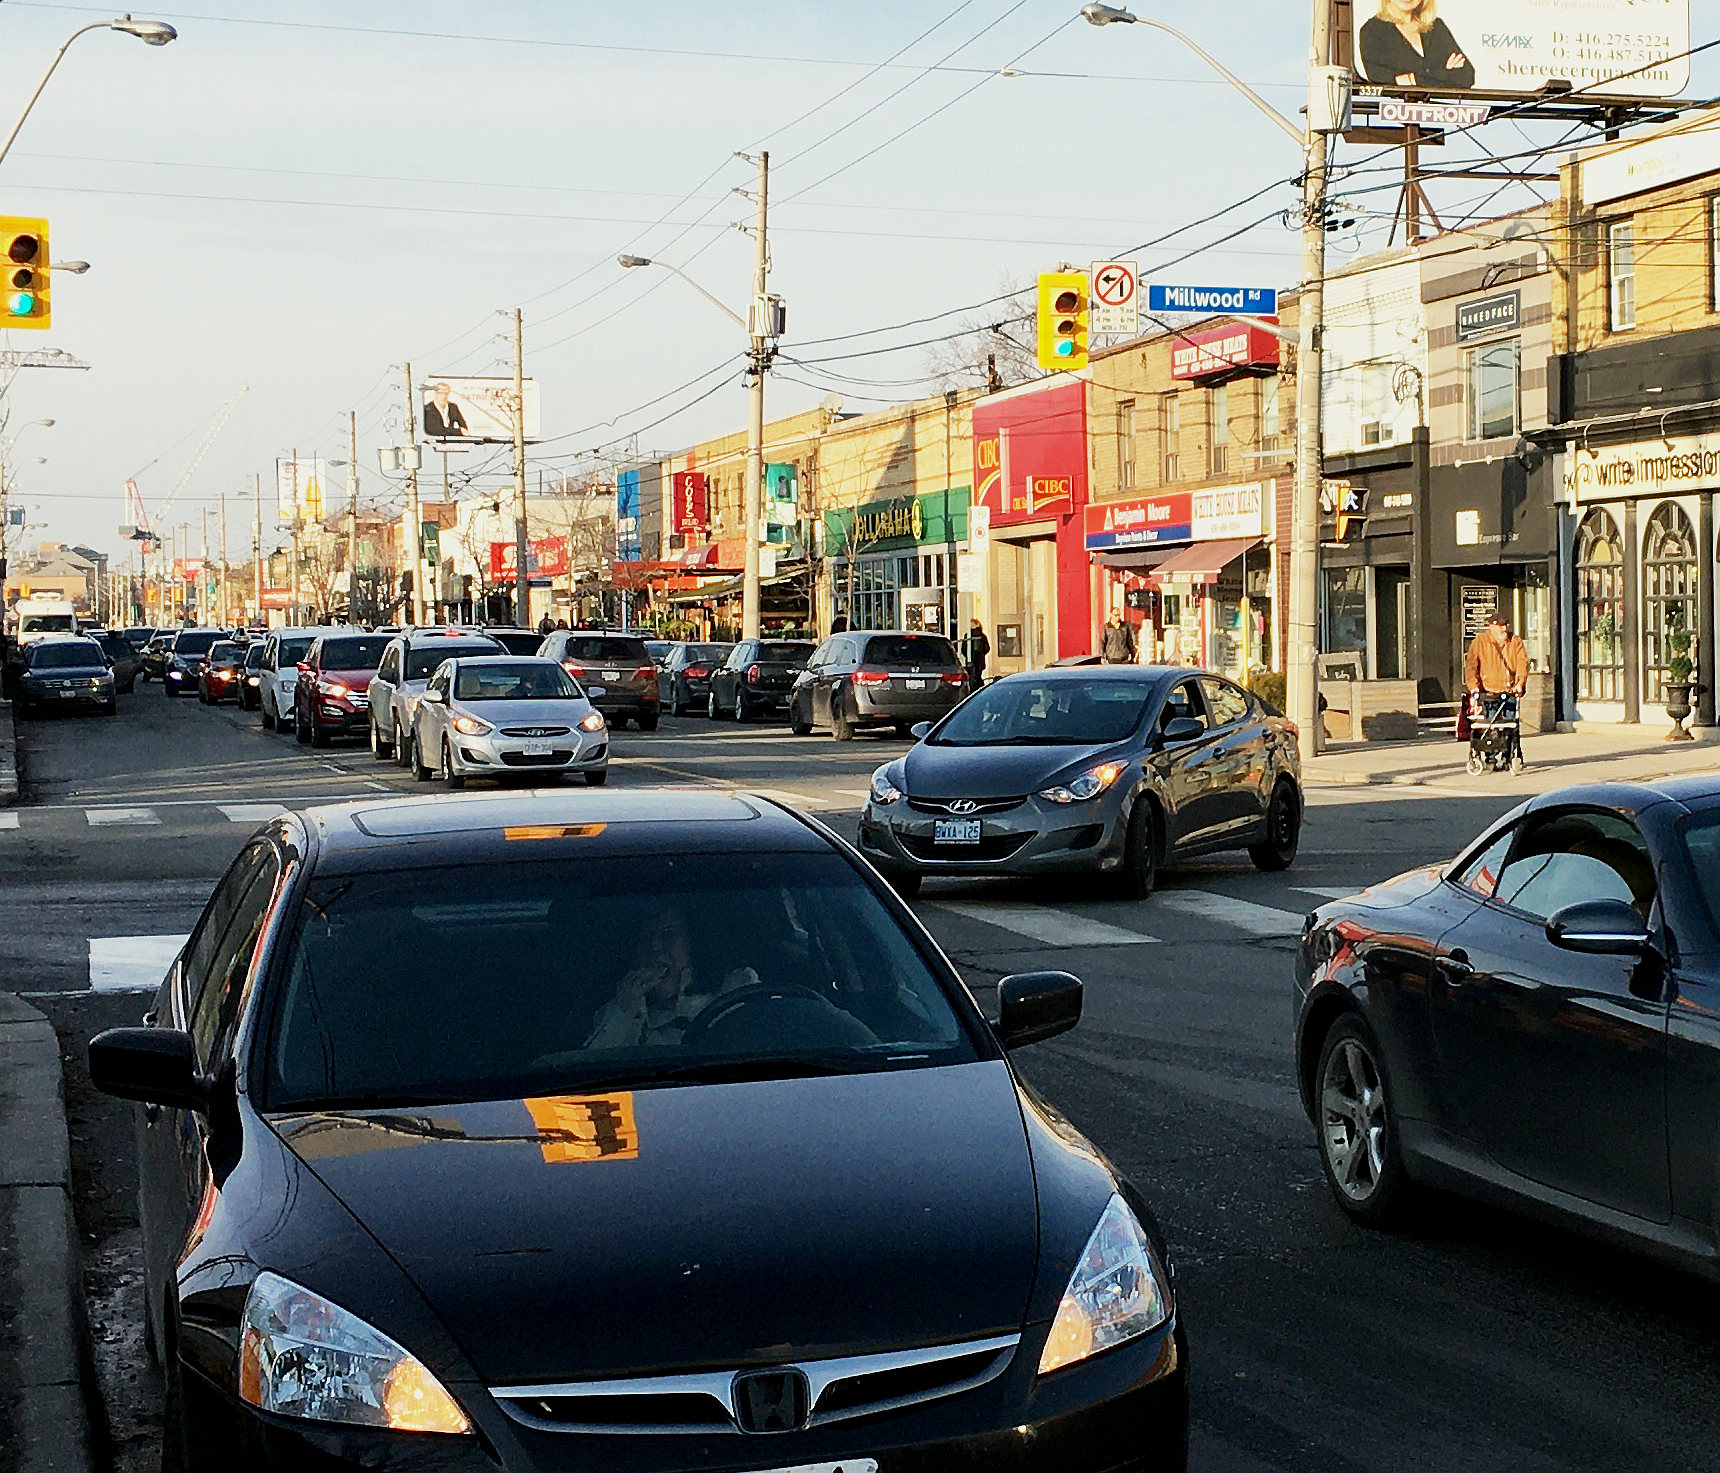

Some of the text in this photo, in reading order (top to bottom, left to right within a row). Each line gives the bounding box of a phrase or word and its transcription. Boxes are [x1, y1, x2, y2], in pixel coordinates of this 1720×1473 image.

[1481, 33, 1533, 49] RE/MAX
[1553, 31, 1669, 47] D: 416.275.5224
[1359, 86, 1383, 96] 3337
[1383, 104, 1484, 124] OUTFRONT
[1165, 287, 1261, 308] Millwood Rd
[1491, 303, 1514, 319] FACE
[978, 437, 1000, 469] CIBC
[1595, 454, 1634, 487] write
[1034, 479, 1069, 494] CIBC
[1114, 502, 1171, 530] Benjamin Moore
